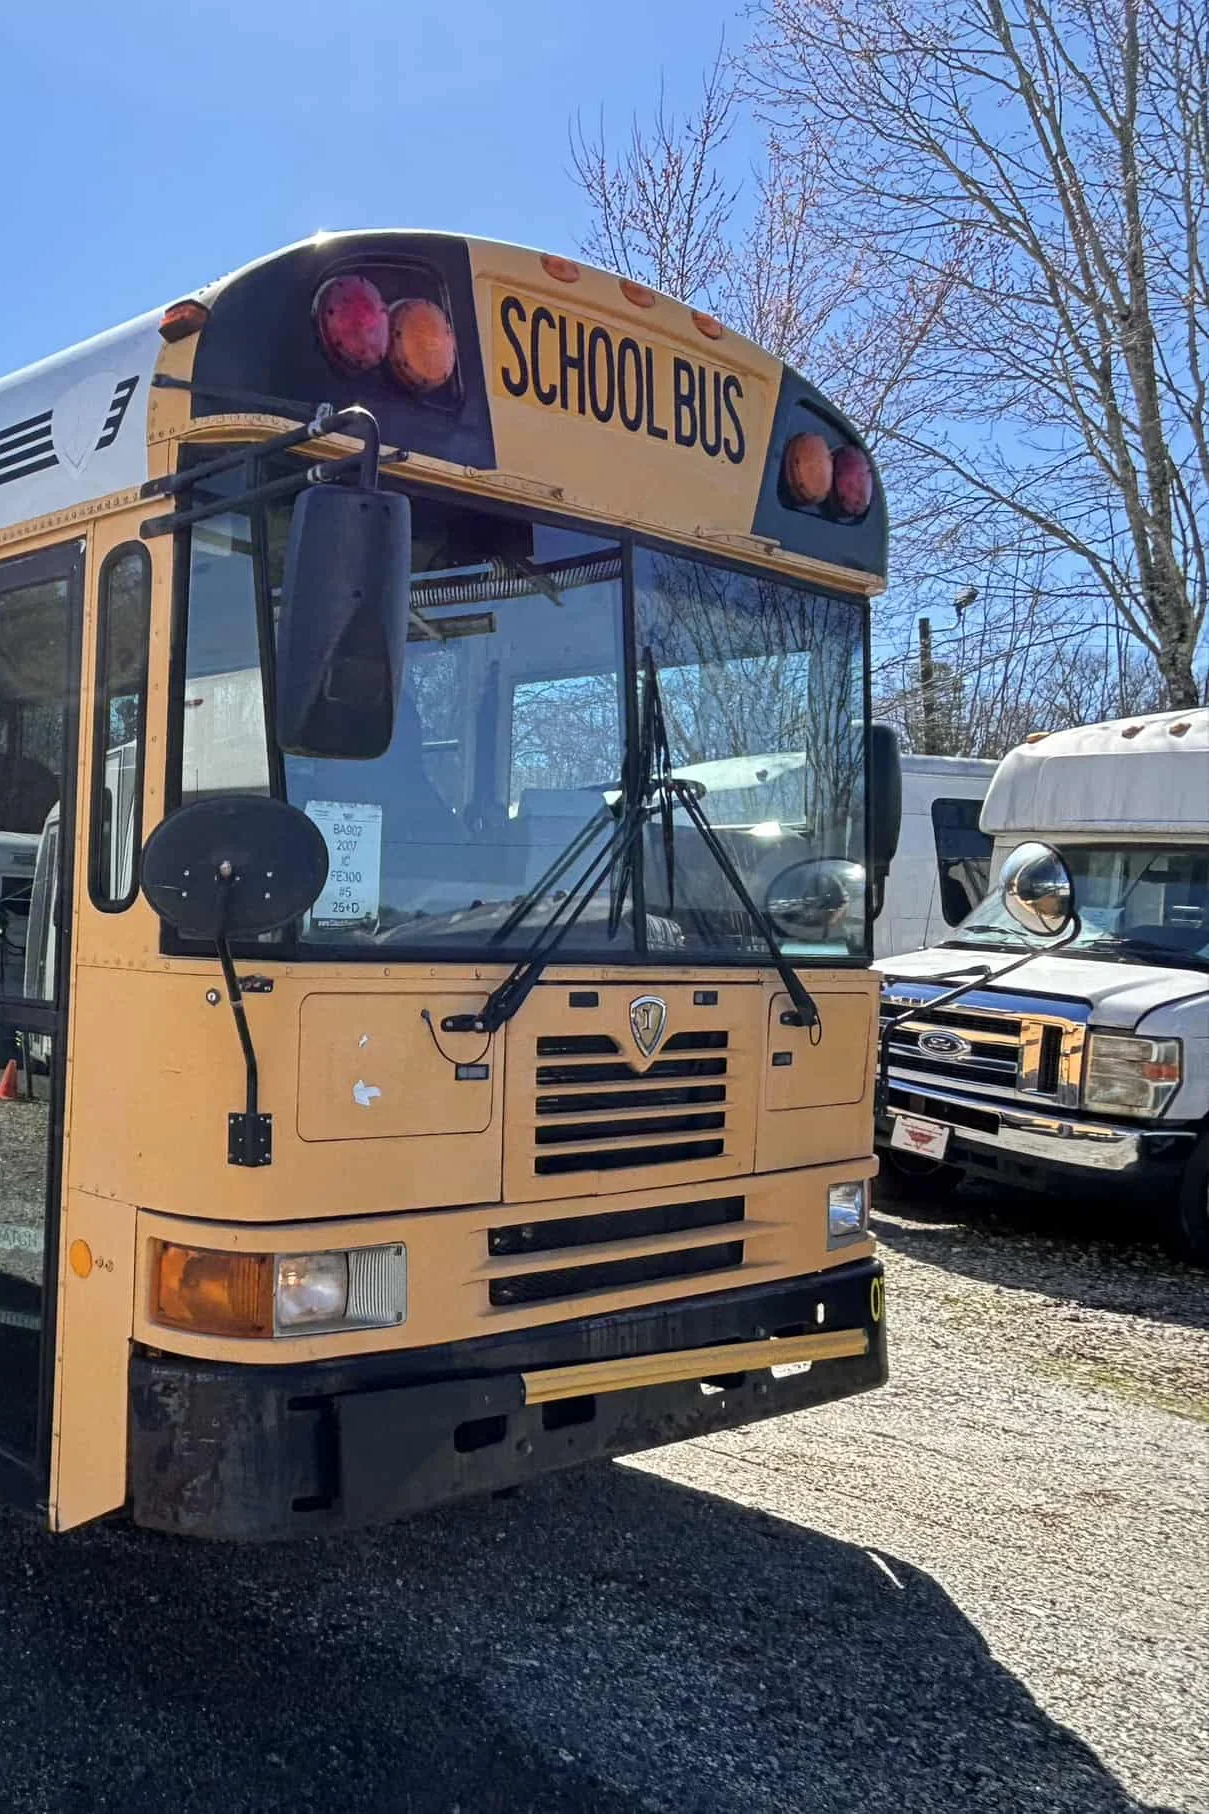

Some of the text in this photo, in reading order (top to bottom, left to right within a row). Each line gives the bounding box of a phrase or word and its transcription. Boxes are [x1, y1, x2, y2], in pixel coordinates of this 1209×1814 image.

[500, 295, 746, 464] SCHOOL BUS
[330, 870, 362, 882] FE300
[332, 902, 359, 913] 25+D
